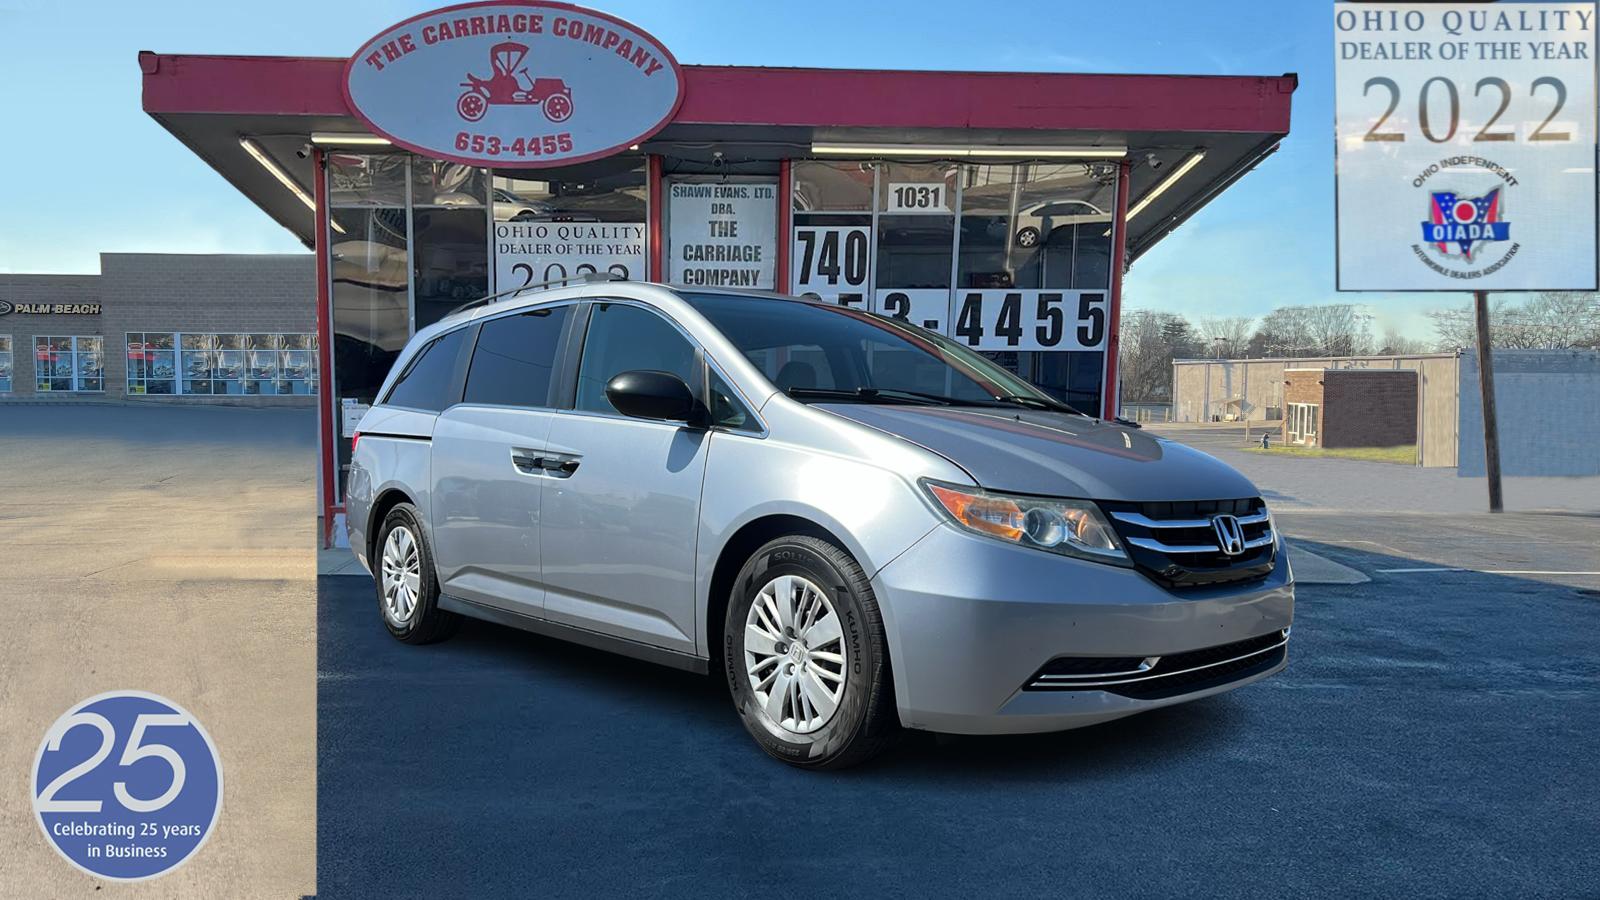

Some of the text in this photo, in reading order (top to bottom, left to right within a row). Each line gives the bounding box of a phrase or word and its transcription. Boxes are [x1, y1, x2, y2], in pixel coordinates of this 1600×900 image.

[1336, 10, 1593, 35] OHIO QUALITY
[365, 14, 665, 77] THE CARRIAGE COMPANY
[1340, 42, 1589, 60] DEALER OF THE YEAR
[1363, 76, 1570, 143] 2022
[454, 131, 573, 156] 653-4455
[1412, 155, 1519, 188] OHIO INDEPENDENT
[672, 186, 713, 199] SHAWN
[754, 187, 775, 199] LTD.
[894, 186, 941, 208] 1031
[711, 203, 736, 215] DBA.
[497, 225, 644, 241] OHIO QUALITY
[708, 220, 738, 238] THE
[1432, 224, 1495, 240] OIADA
[500, 244, 641, 255] DEALER OF THE YEAR
[683, 245, 762, 262] CARRIAGE
[797, 229, 868, 286] 740
[1411, 242, 1520, 279] AUTOMOBILE DEALERS ASSOCIATION
[511, 263, 630, 297] 20
[683, 268, 760, 286] COMPANY
[15, 304, 50, 314] PALM
[845, 611, 862, 675] KUMHO
